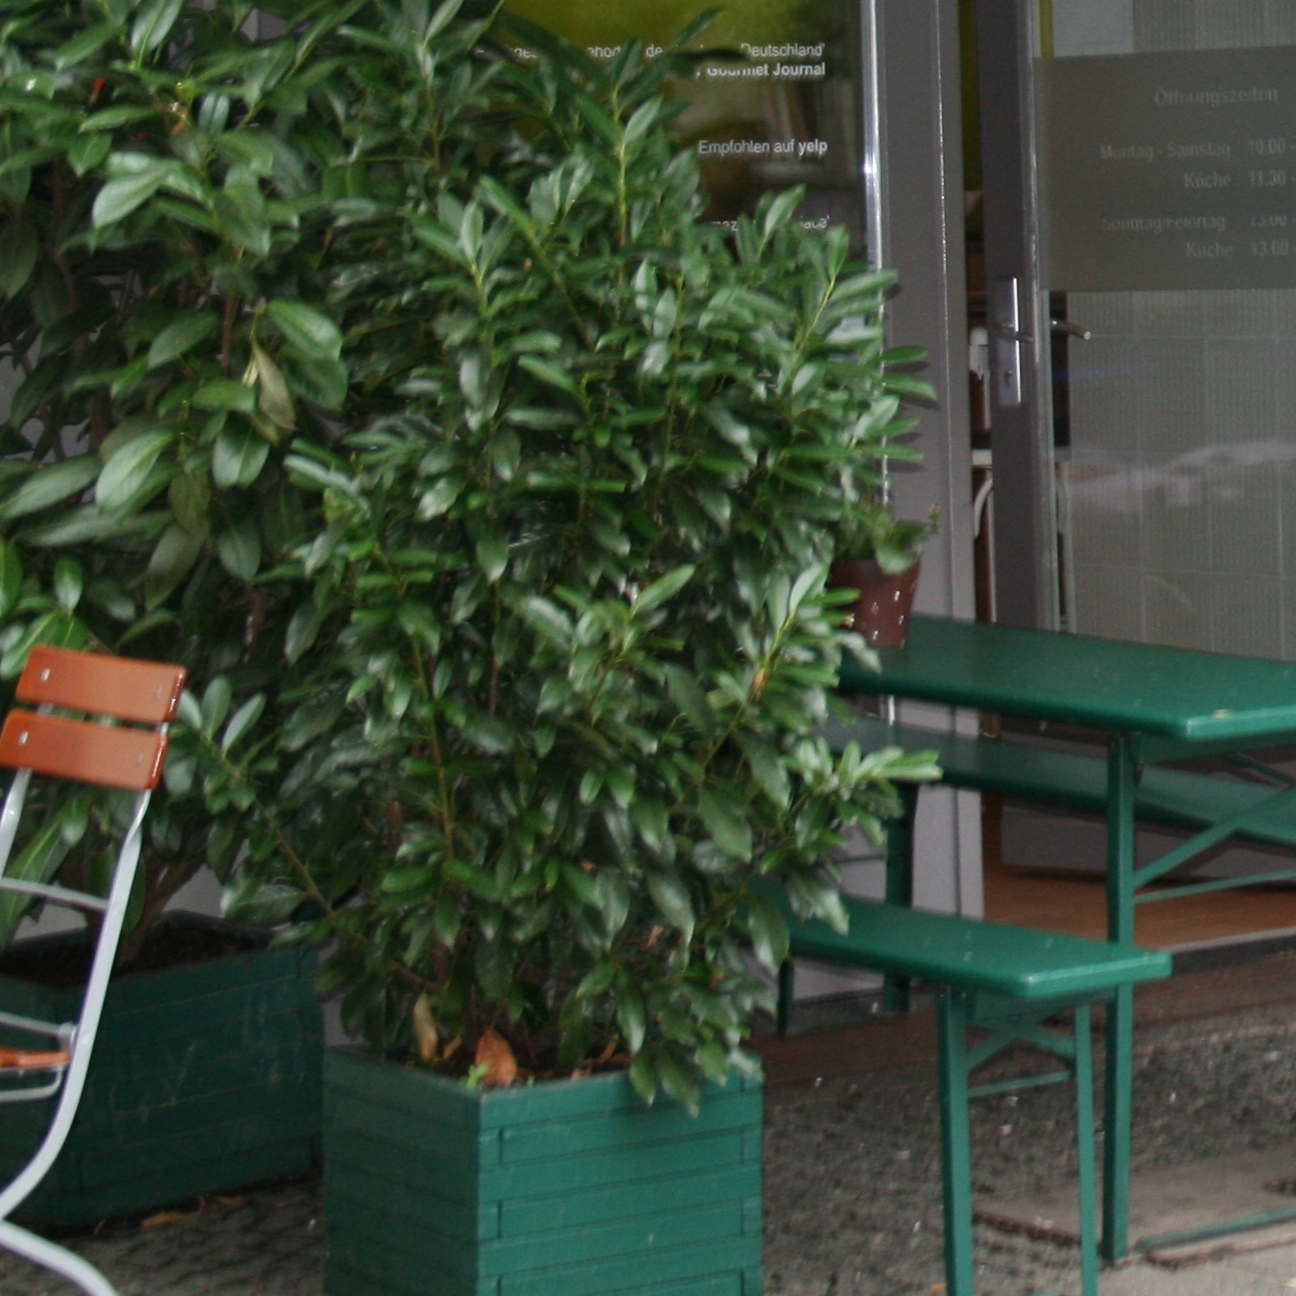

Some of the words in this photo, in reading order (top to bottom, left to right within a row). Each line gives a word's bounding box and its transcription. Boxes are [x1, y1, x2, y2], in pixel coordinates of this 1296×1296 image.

[772, 61, 826, 77] Journal
[699, 139, 770, 157] Empfohlen
[774, 138, 795, 154] auf
[798, 137, 828, 156] yelp
